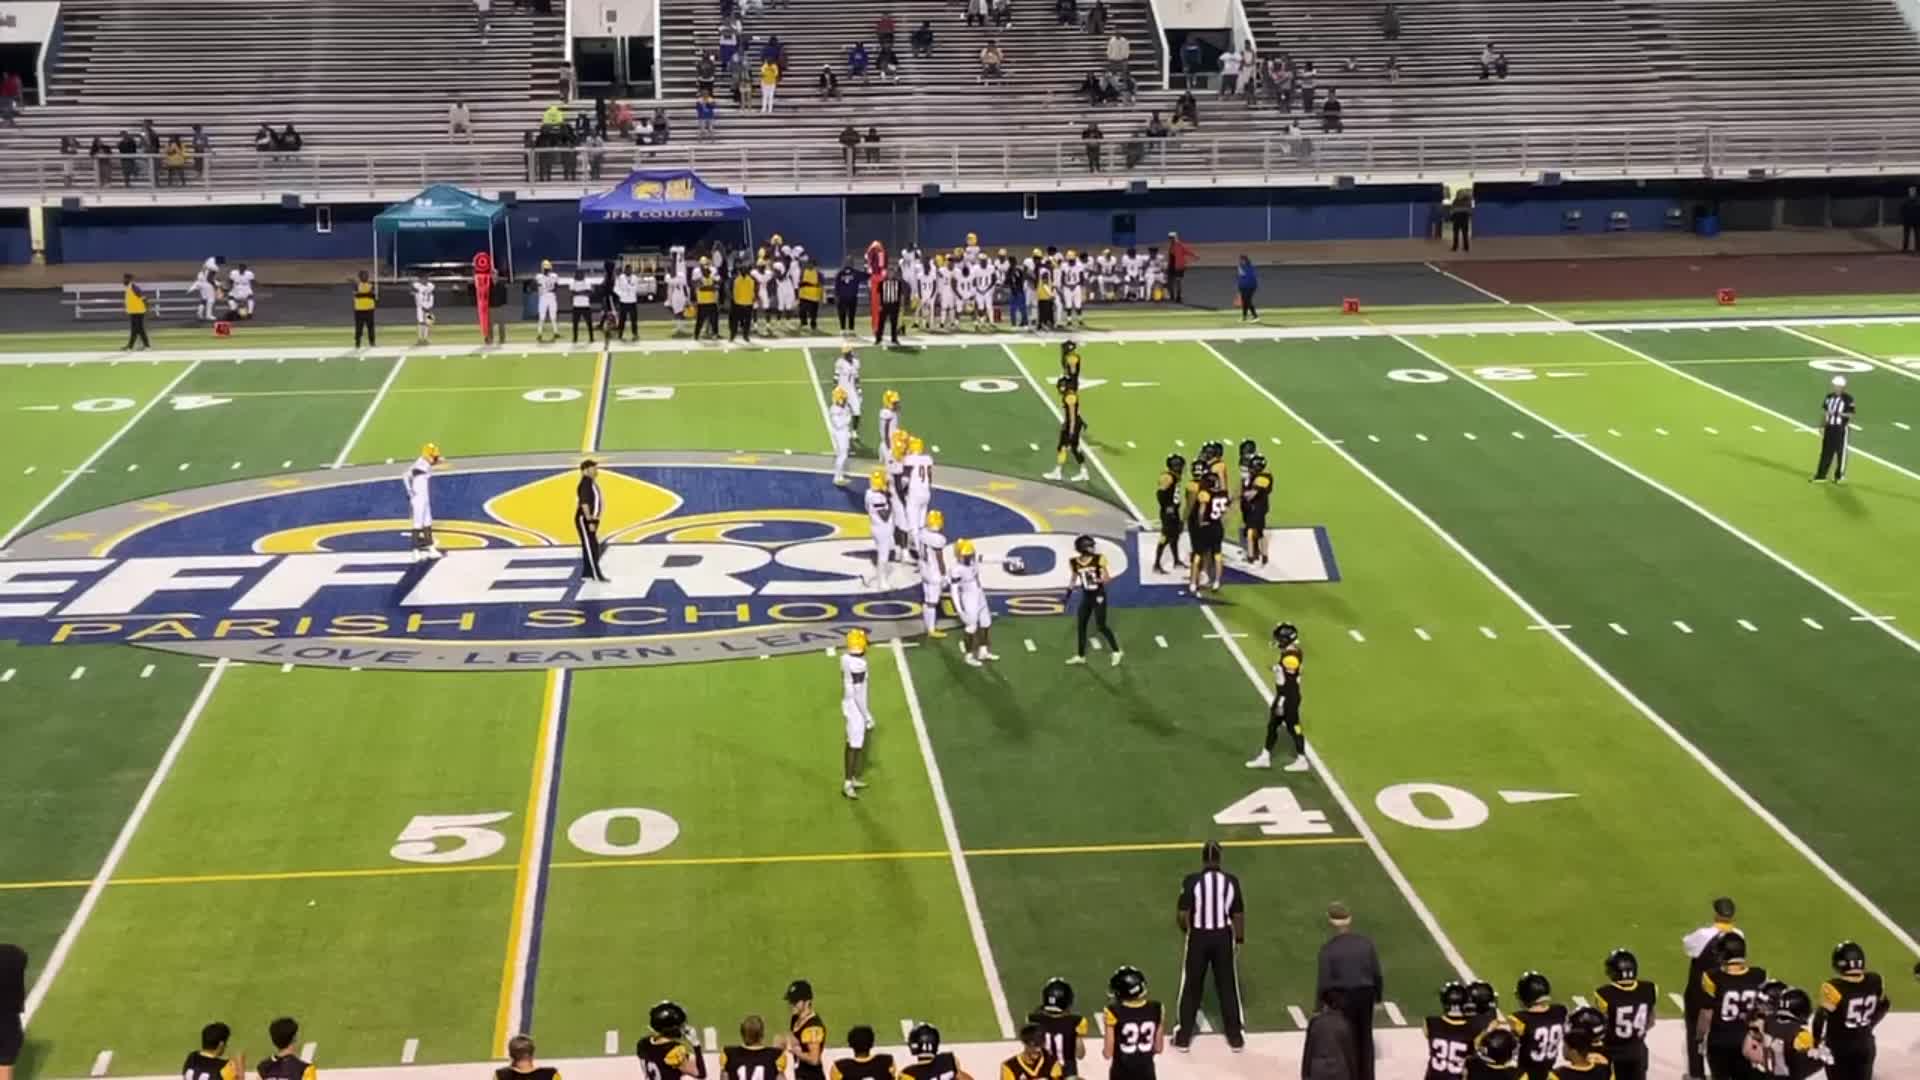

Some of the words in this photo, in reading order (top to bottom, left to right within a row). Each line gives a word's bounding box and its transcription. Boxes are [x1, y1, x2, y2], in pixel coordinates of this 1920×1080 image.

[603, 209, 633, 220] JFK
[638, 208, 724, 219] COUGARS
[51, 611, 476, 642] PARISH
[256, 643, 422, 664] LOVE
[464, 645, 678, 665] LEARN
[1615, 1002, 1649, 1038] 54
[1119, 1021, 1156, 1054] 33
[1431, 1038, 1467, 1074] 35
